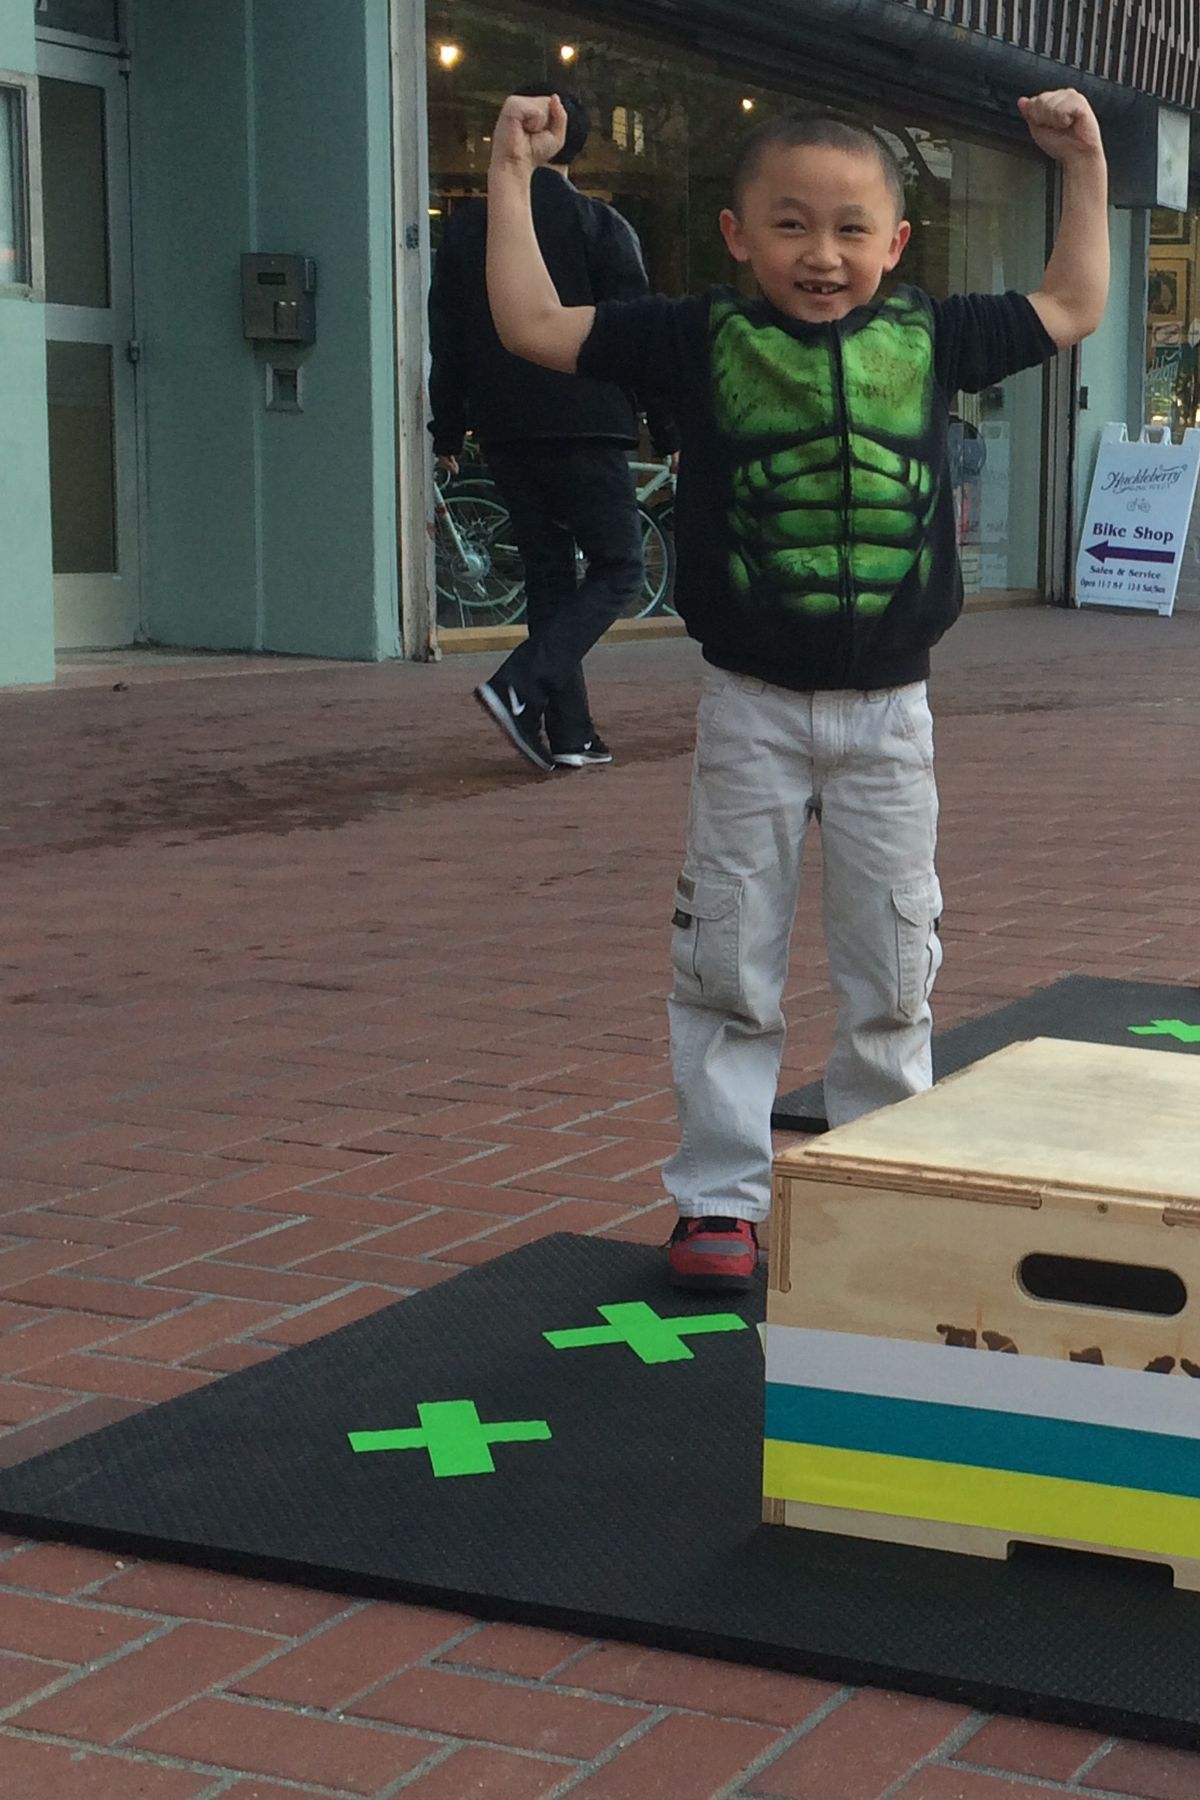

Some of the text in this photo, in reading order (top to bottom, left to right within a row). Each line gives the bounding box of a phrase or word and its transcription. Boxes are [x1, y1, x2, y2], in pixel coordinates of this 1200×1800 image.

[1101, 464, 1187, 493] Huckleberry
[1092, 522, 1174, 545] Bike Shop
[1089, 565, 1161, 580] Sales & Service
[1080, 577, 1096, 589] Open
